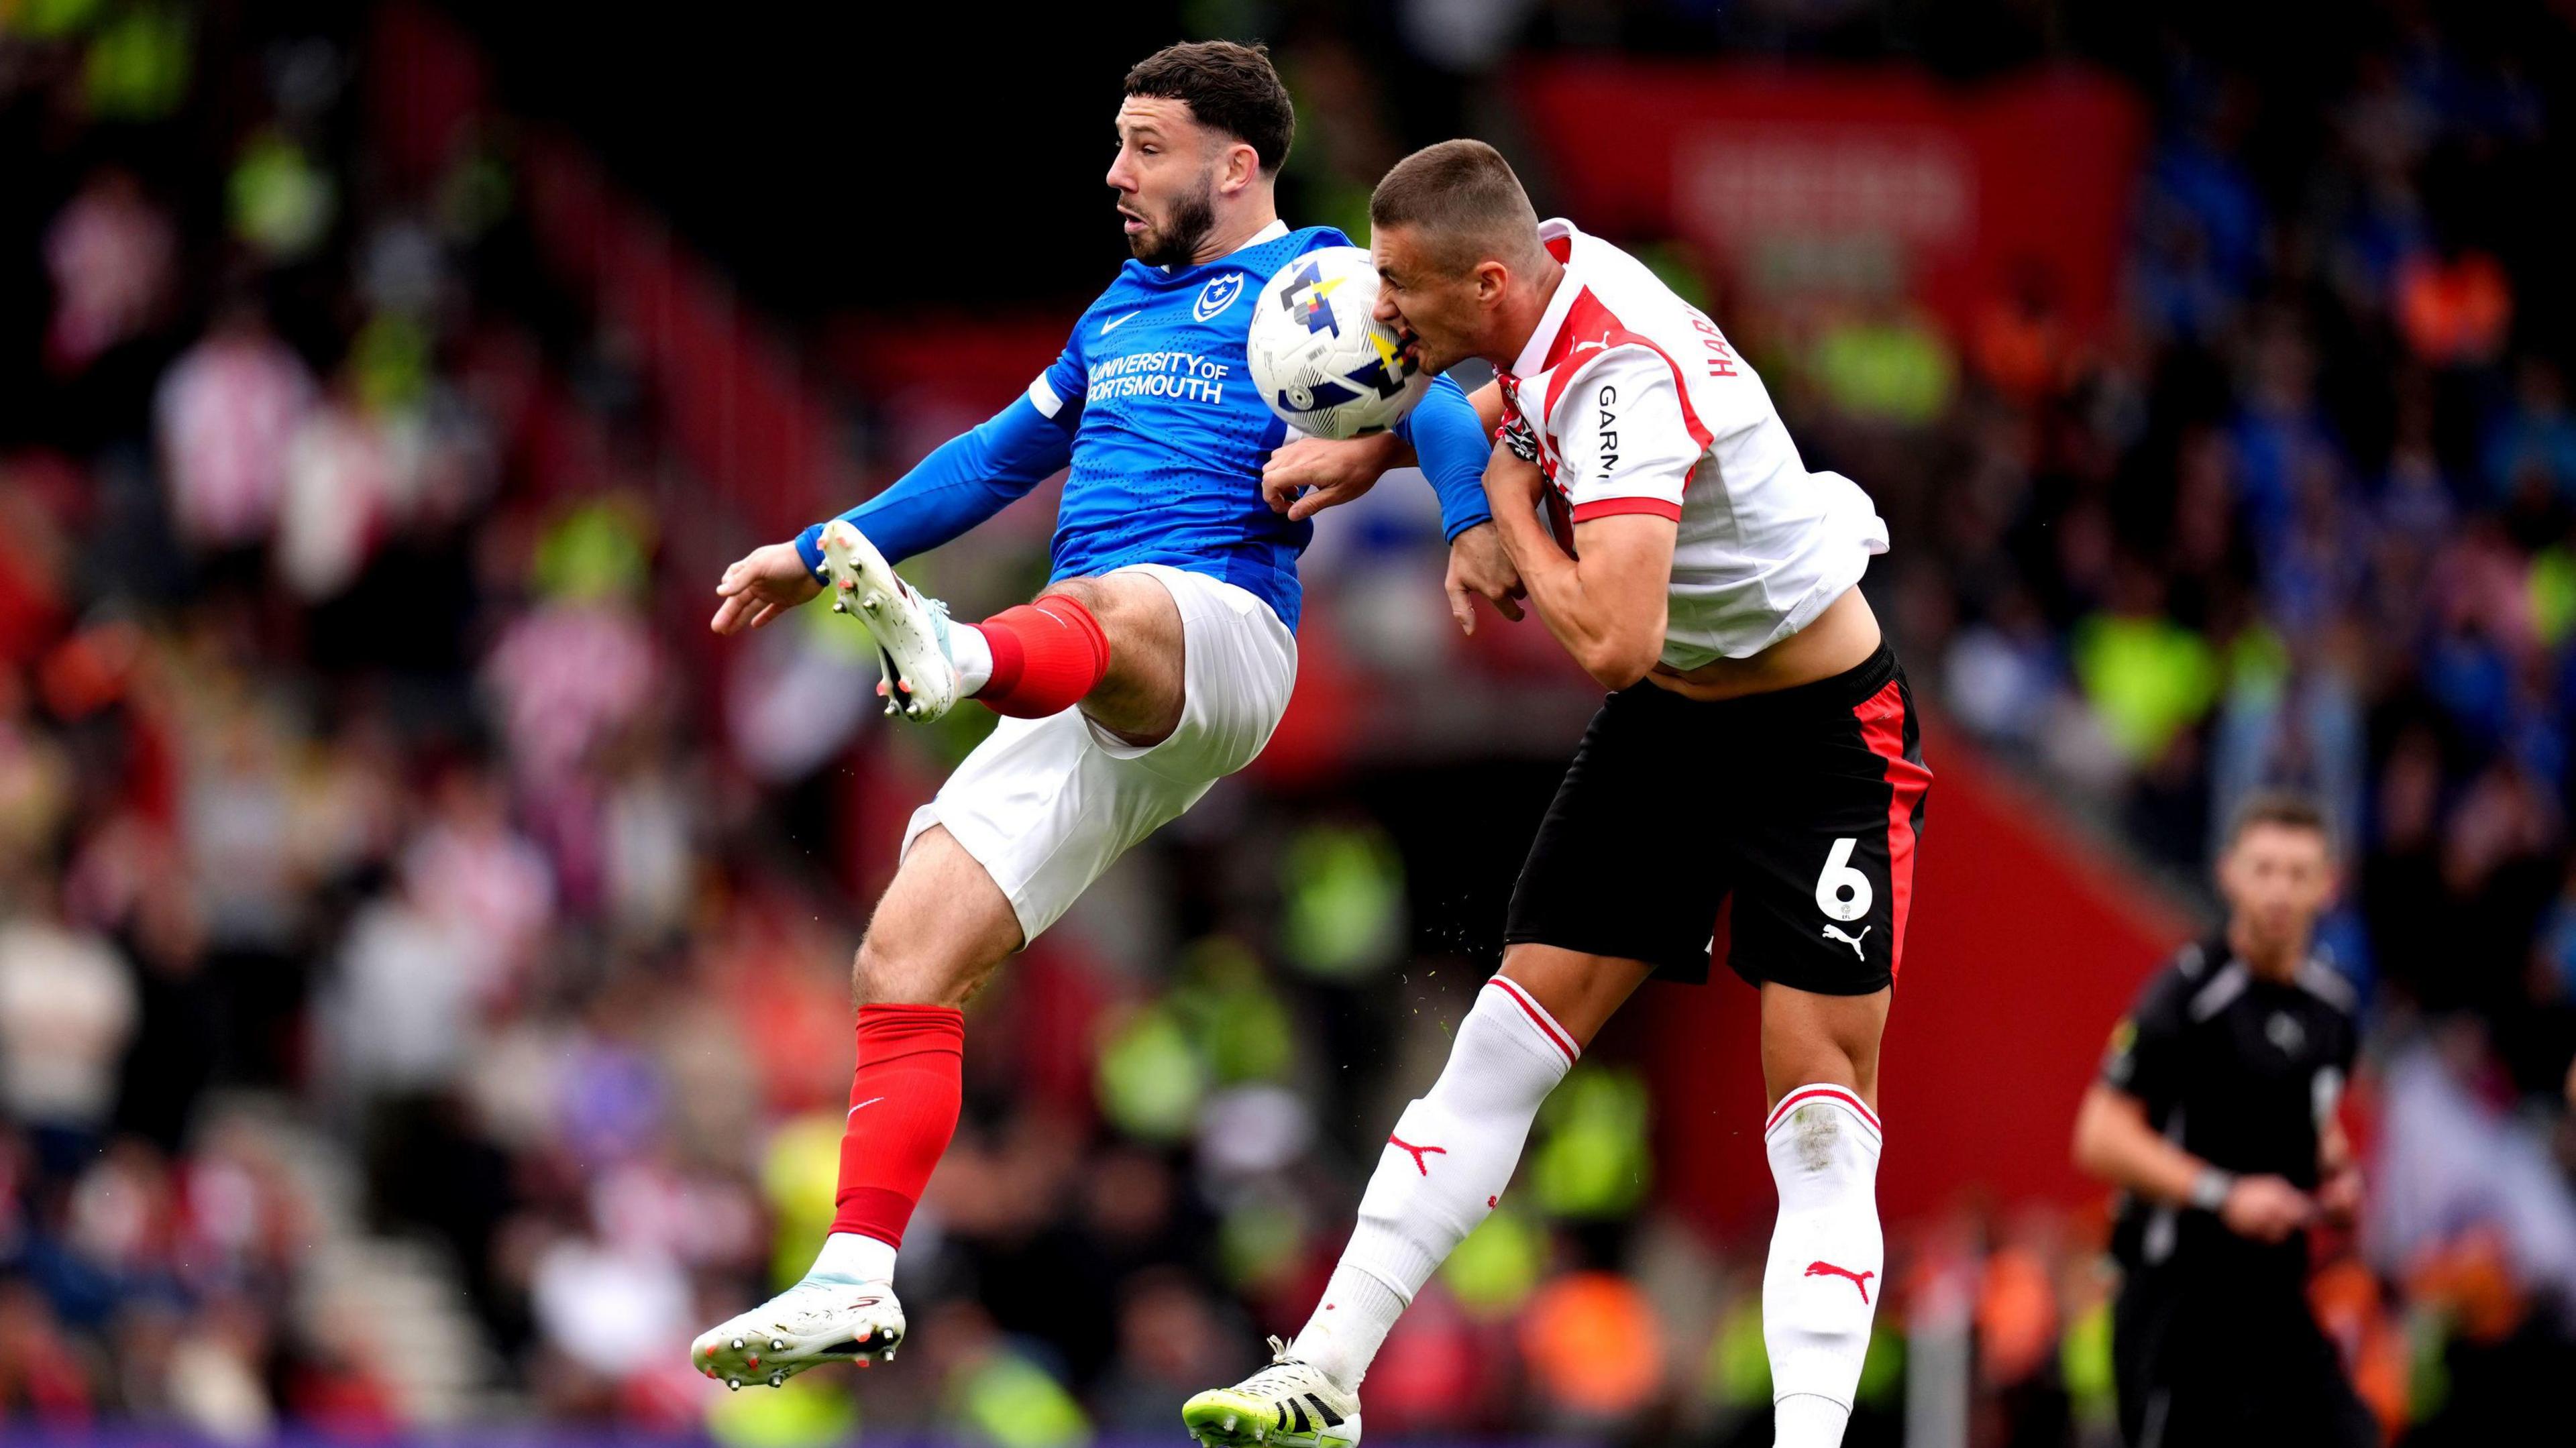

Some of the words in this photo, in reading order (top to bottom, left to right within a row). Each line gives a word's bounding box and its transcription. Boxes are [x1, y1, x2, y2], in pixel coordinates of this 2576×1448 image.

[1093, 352, 1205, 382] UNIVERSITY
[1201, 362, 1229, 380] OF
[1086, 374, 1223, 404] PORTSMOUTH
[1815, 838, 1873, 922] 6
